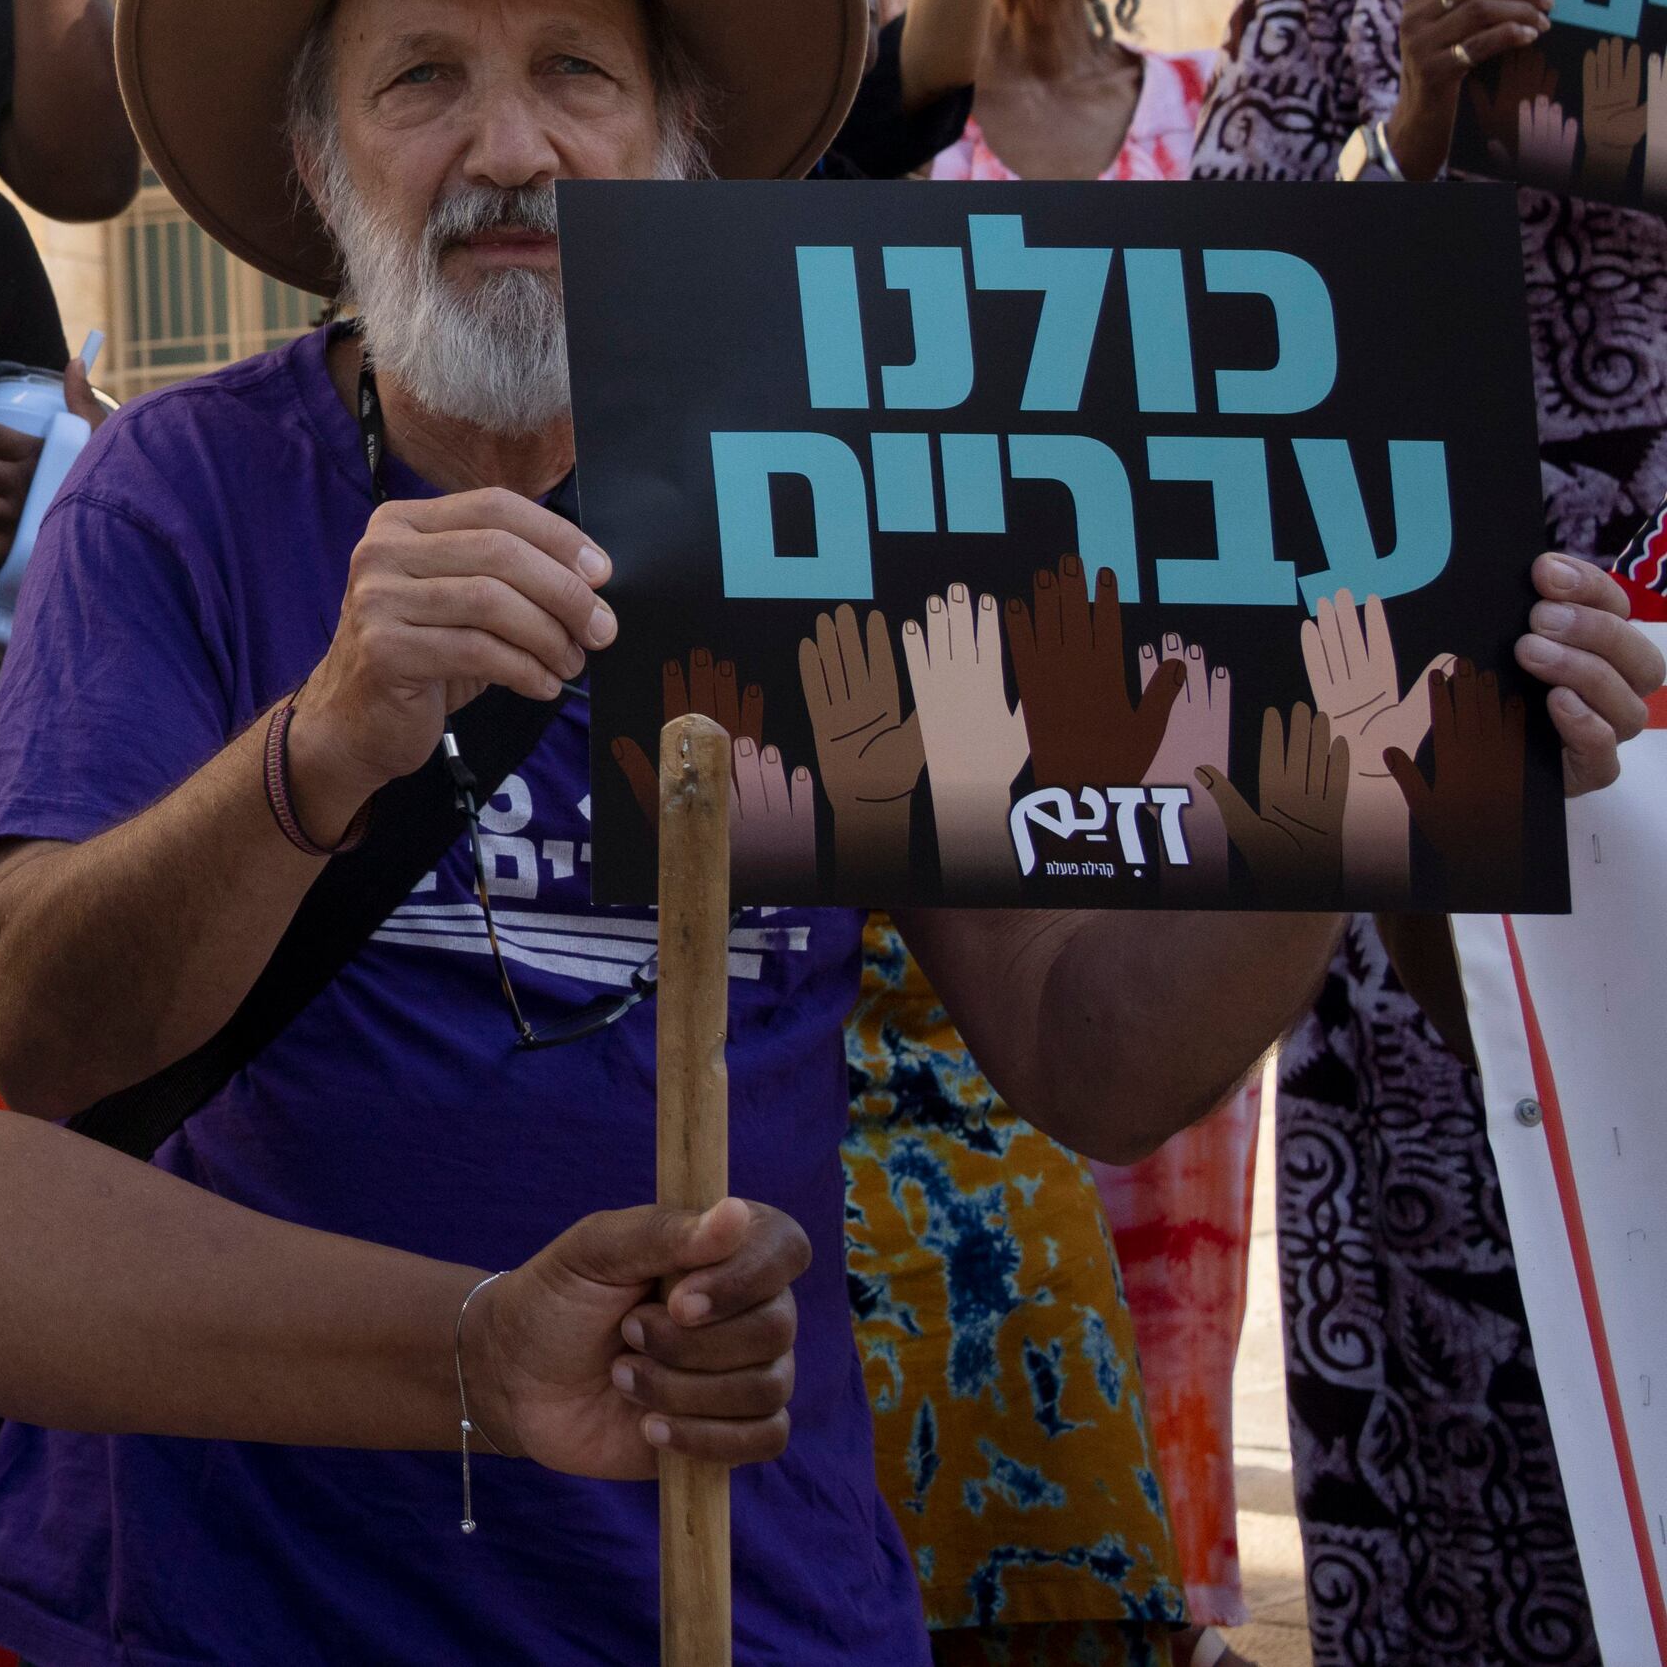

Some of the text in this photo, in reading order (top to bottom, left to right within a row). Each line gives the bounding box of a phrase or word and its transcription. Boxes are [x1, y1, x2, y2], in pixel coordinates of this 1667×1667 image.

[795, 212, 1338, 414] כולנו
[709, 430, 1454, 615] עבריים
[1045, 860, 1115, 878] קהילה פועלת
